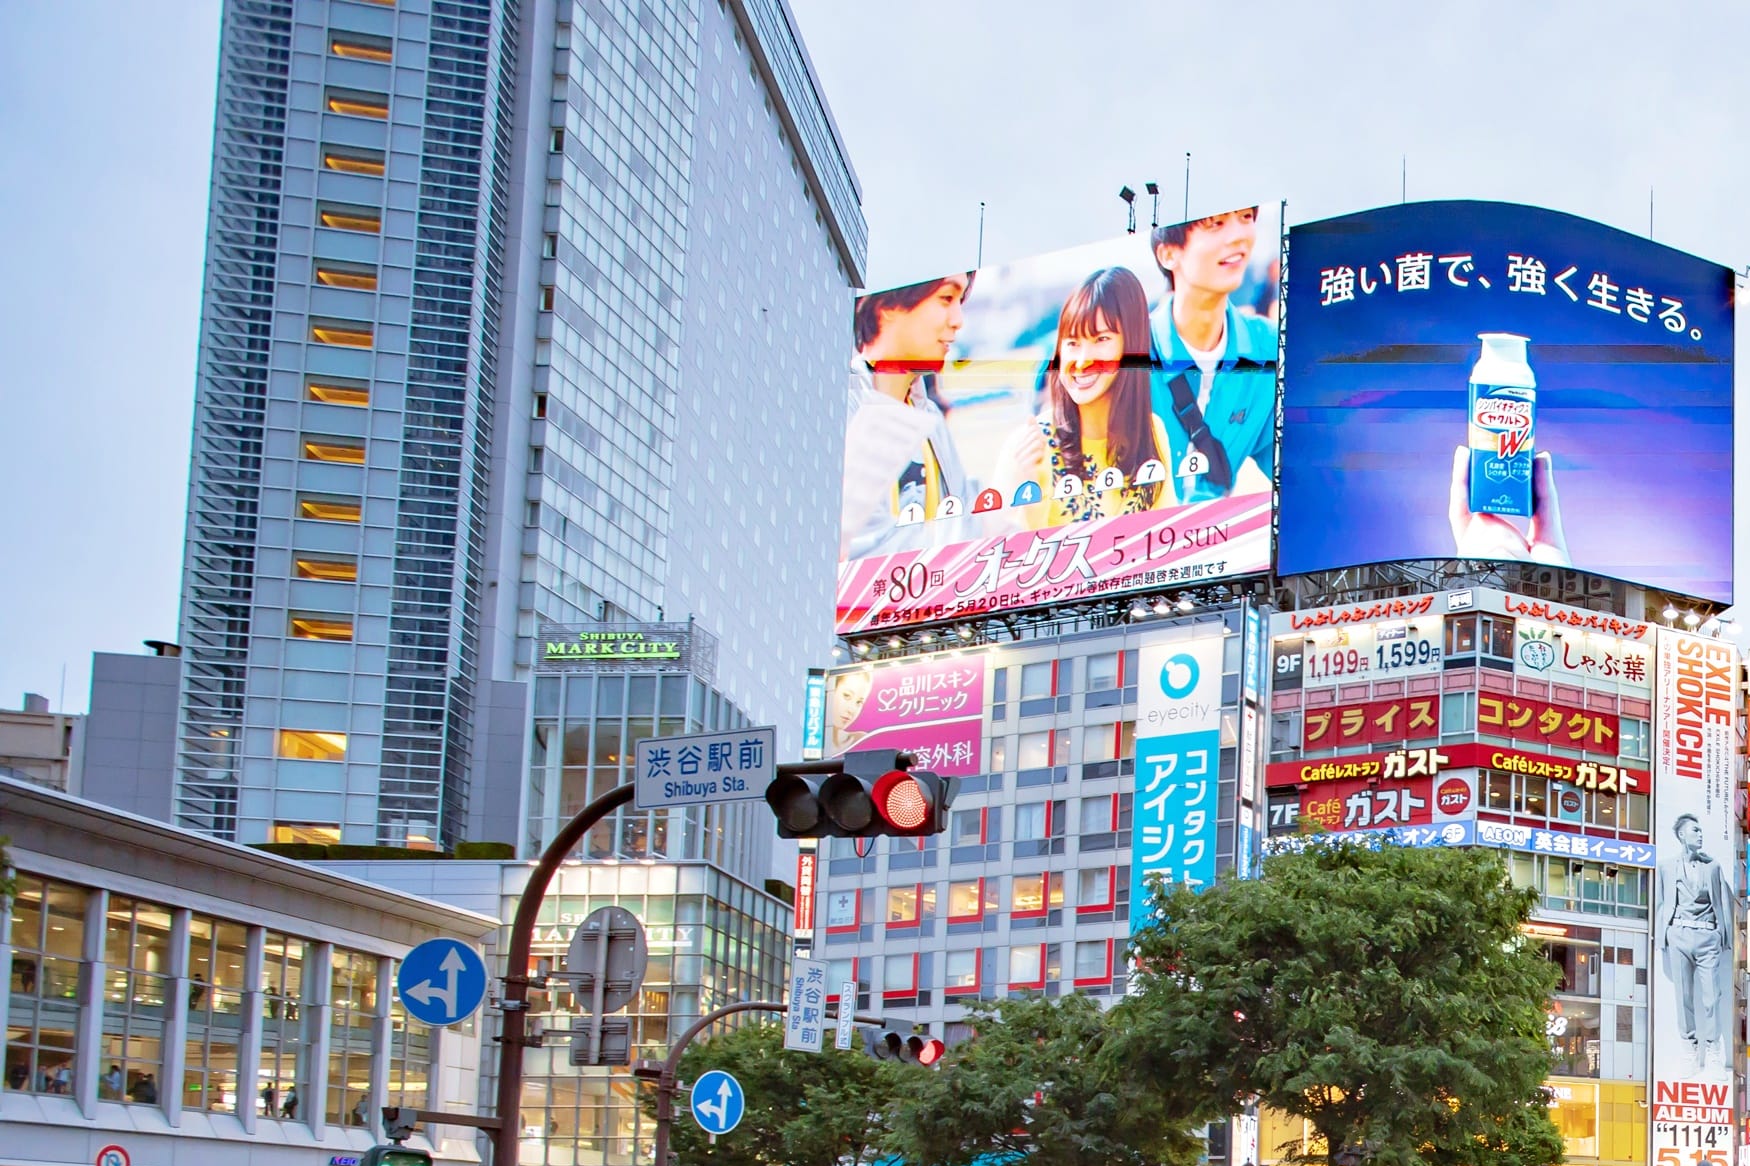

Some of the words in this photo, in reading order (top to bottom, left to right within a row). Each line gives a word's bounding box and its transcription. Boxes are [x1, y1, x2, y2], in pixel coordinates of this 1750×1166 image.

[1320, 253, 1702, 341] 強い菌で、強く生きる。
[1500, 428, 1528, 457] W
[907, 507, 916, 522] 1
[944, 500, 954, 514] 2
[983, 493, 994, 508] 3
[1021, 486, 1033, 501] 4
[1063, 479, 1073, 494] 5
[1104, 472, 1114, 487] 6
[1146, 465, 1157, 479] 7
[1188, 457, 1199, 472] 8
[873, 562, 945, 602] 第80回
[954, 532, 1099, 599] オークス
[1110, 527, 1177, 566] 5.19
[1182, 523, 1229, 550] SUN
[546, 642, 614, 654] MARK
[620, 641, 677, 654] CITY
[579, 632, 644, 641] SHIBUYA
[1276, 654, 1301, 674] 9F
[1562, 641, 1646, 682] しゃぶ葉
[899, 668, 978, 696] 品川スキン
[1705, 644, 1731, 727] EXILE
[898, 690, 969, 717] クリニック
[1147, 702, 1211, 725] eyecity
[1676, 638, 1703, 780] SHOKICHI
[1306, 700, 1435, 742] プライス
[1479, 697, 1615, 743] コンタクト
[647, 738, 764, 778] 渋谷駅前
[901, 739, 974, 771] 容外科
[1384, 749, 1449, 780] ガスト
[664, 778, 717, 799] Shibuya
[722, 776, 750, 793] Sta.
[1575, 762, 1639, 795] ガスト
[1270, 803, 1300, 826] 7F
[1307, 798, 1341, 818] Café
[1344, 788, 1425, 828] ガスト
[1440, 794, 1468, 806] ガスト
[1482, 826, 1526, 846] AEON
[1535, 831, 1653, 863] 英会話イーオン
[792, 976, 805, 1012] Shibuya
[801, 967, 823, 1045] 渋谷駅前
[1657, 1080, 1729, 1106] NEW
[1656, 1105, 1729, 1123] ALBUM
